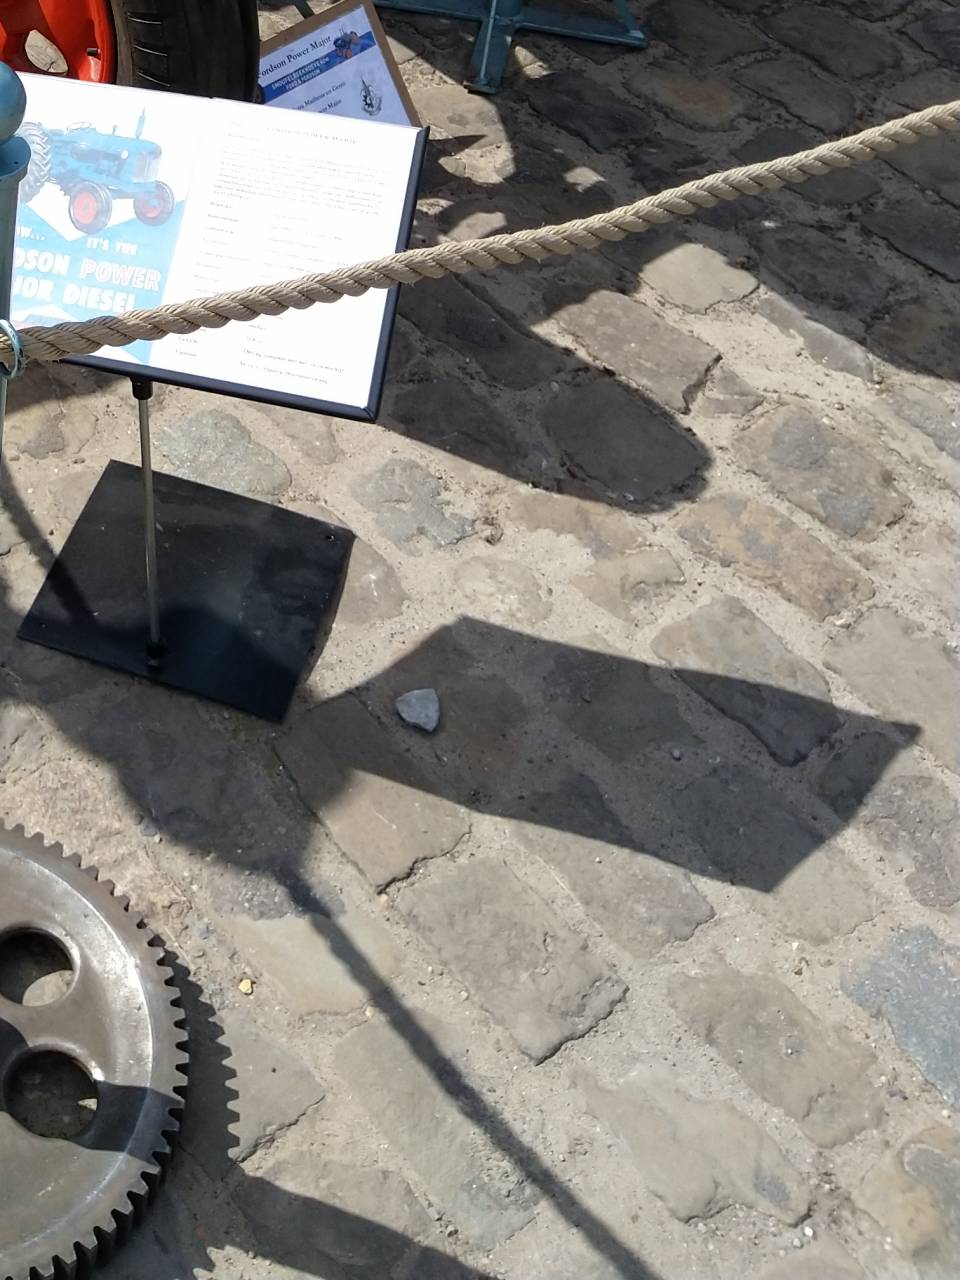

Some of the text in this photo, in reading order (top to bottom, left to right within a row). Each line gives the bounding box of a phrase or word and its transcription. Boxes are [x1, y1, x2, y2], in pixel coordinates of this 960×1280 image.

[286, 45, 310, 63] Power
[309, 34, 332, 52] Major
[87, 237, 109, 251] IT'S
[14, 247, 161, 291] DSON POWER
[12, 275, 54, 302] JOR
